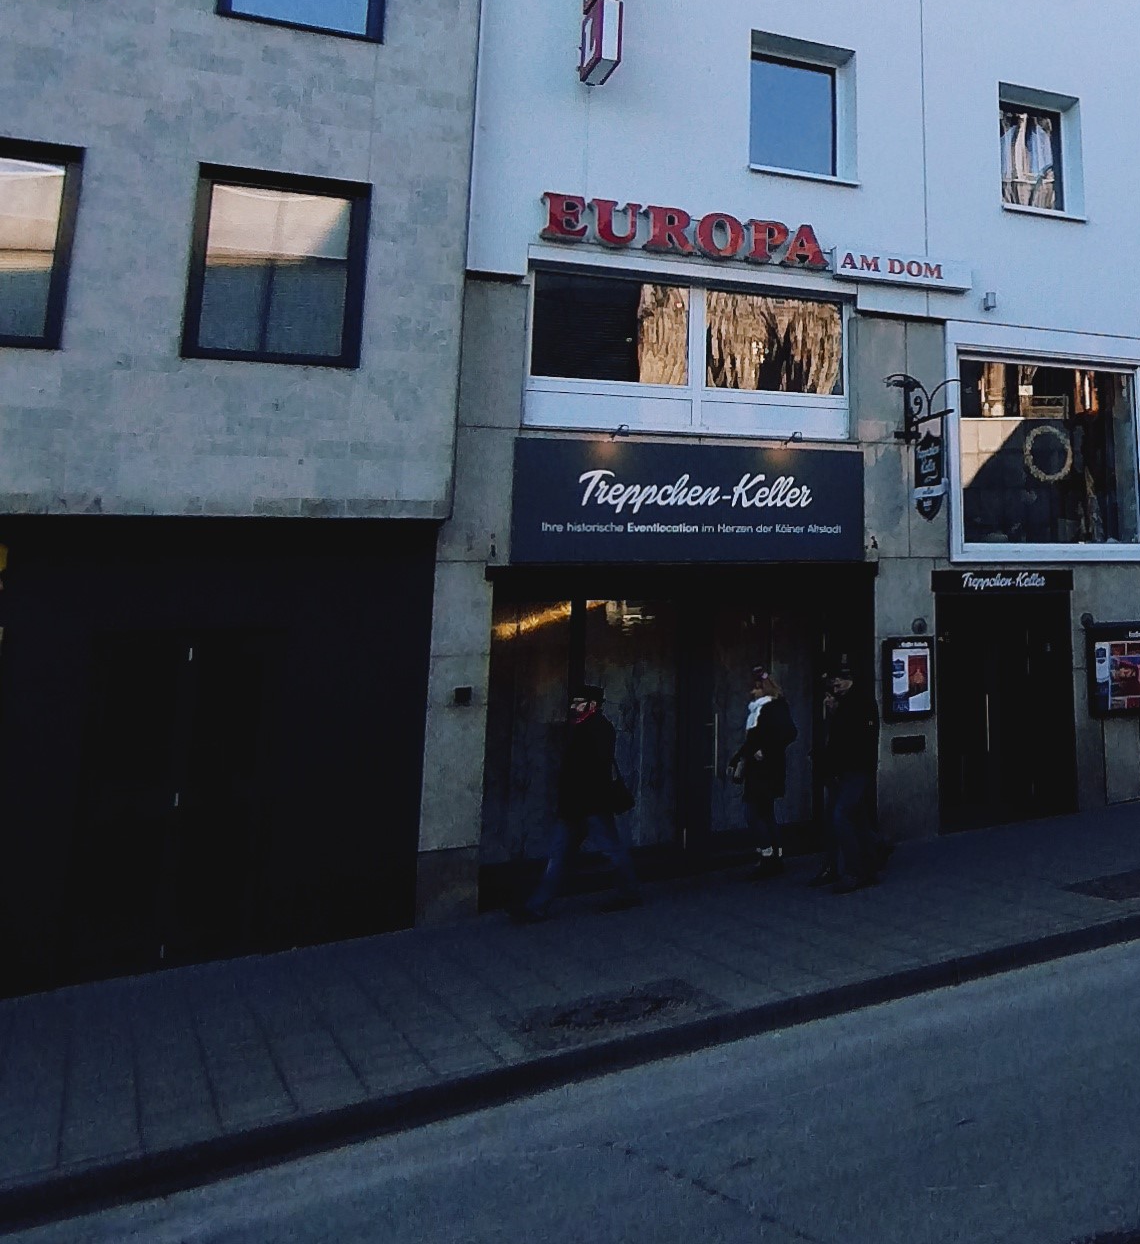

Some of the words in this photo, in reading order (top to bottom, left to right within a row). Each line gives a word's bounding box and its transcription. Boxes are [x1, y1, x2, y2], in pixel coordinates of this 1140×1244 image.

[541, 192, 829, 270] EUROPA
[840, 252, 881, 273] AM
[888, 258, 944, 280] DOM
[578, 469, 813, 514] Treppchen-Keller
[541, 522, 563, 533] Ihre
[566, 522, 624, 533] historische
[627, 522, 699, 534] Eventlocation
[701, 523, 715, 534] im
[717, 523, 753, 534] Herzen
[755, 523, 772, 534] der
[775, 523, 804, 534] Kölner
[807, 523, 842, 535] Altstadt
[961, 571, 1046, 591] Treppchen-Keller
